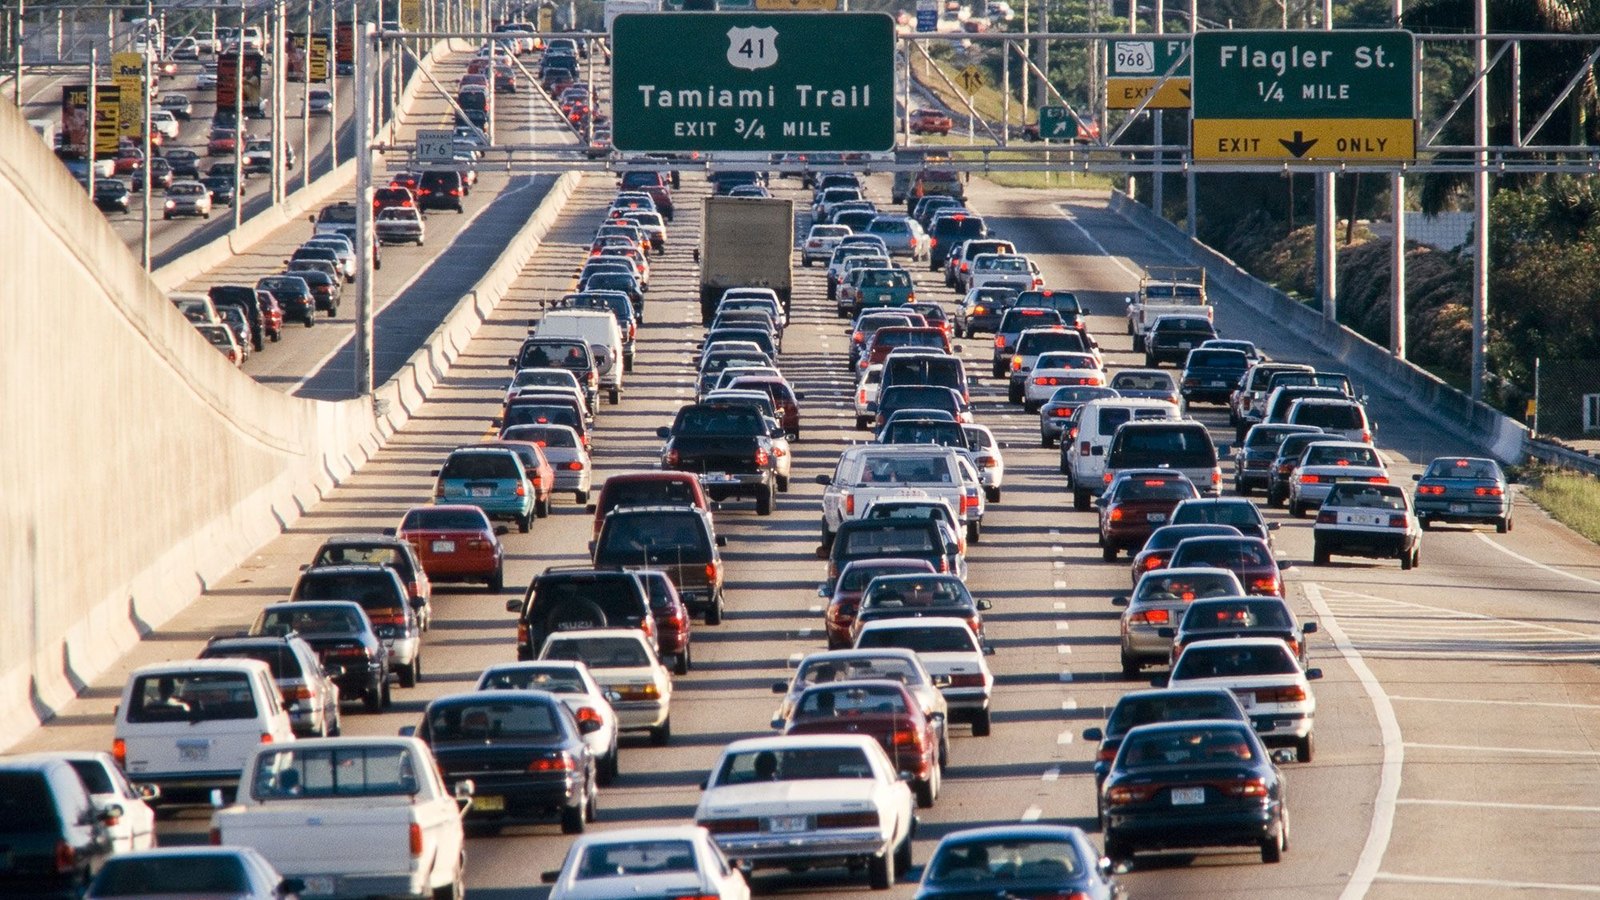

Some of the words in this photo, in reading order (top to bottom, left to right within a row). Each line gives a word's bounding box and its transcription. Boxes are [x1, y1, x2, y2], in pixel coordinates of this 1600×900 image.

[738, 38, 765, 59] 41
[1117, 52, 1144, 67] 968
[1220, 45, 1333, 76] Flagler
[1354, 45, 1395, 69] St.
[638, 84, 775, 107] Tamiami
[796, 84, 870, 107] Trail
[1124, 87, 1154, 99] EXI
[1302, 84, 1350, 100] MILE
[674, 121, 717, 137] EXIT
[783, 121, 831, 137] MILE
[1218, 138, 1261, 152] EXIT
[1336, 138, 1388, 152] ONLY
